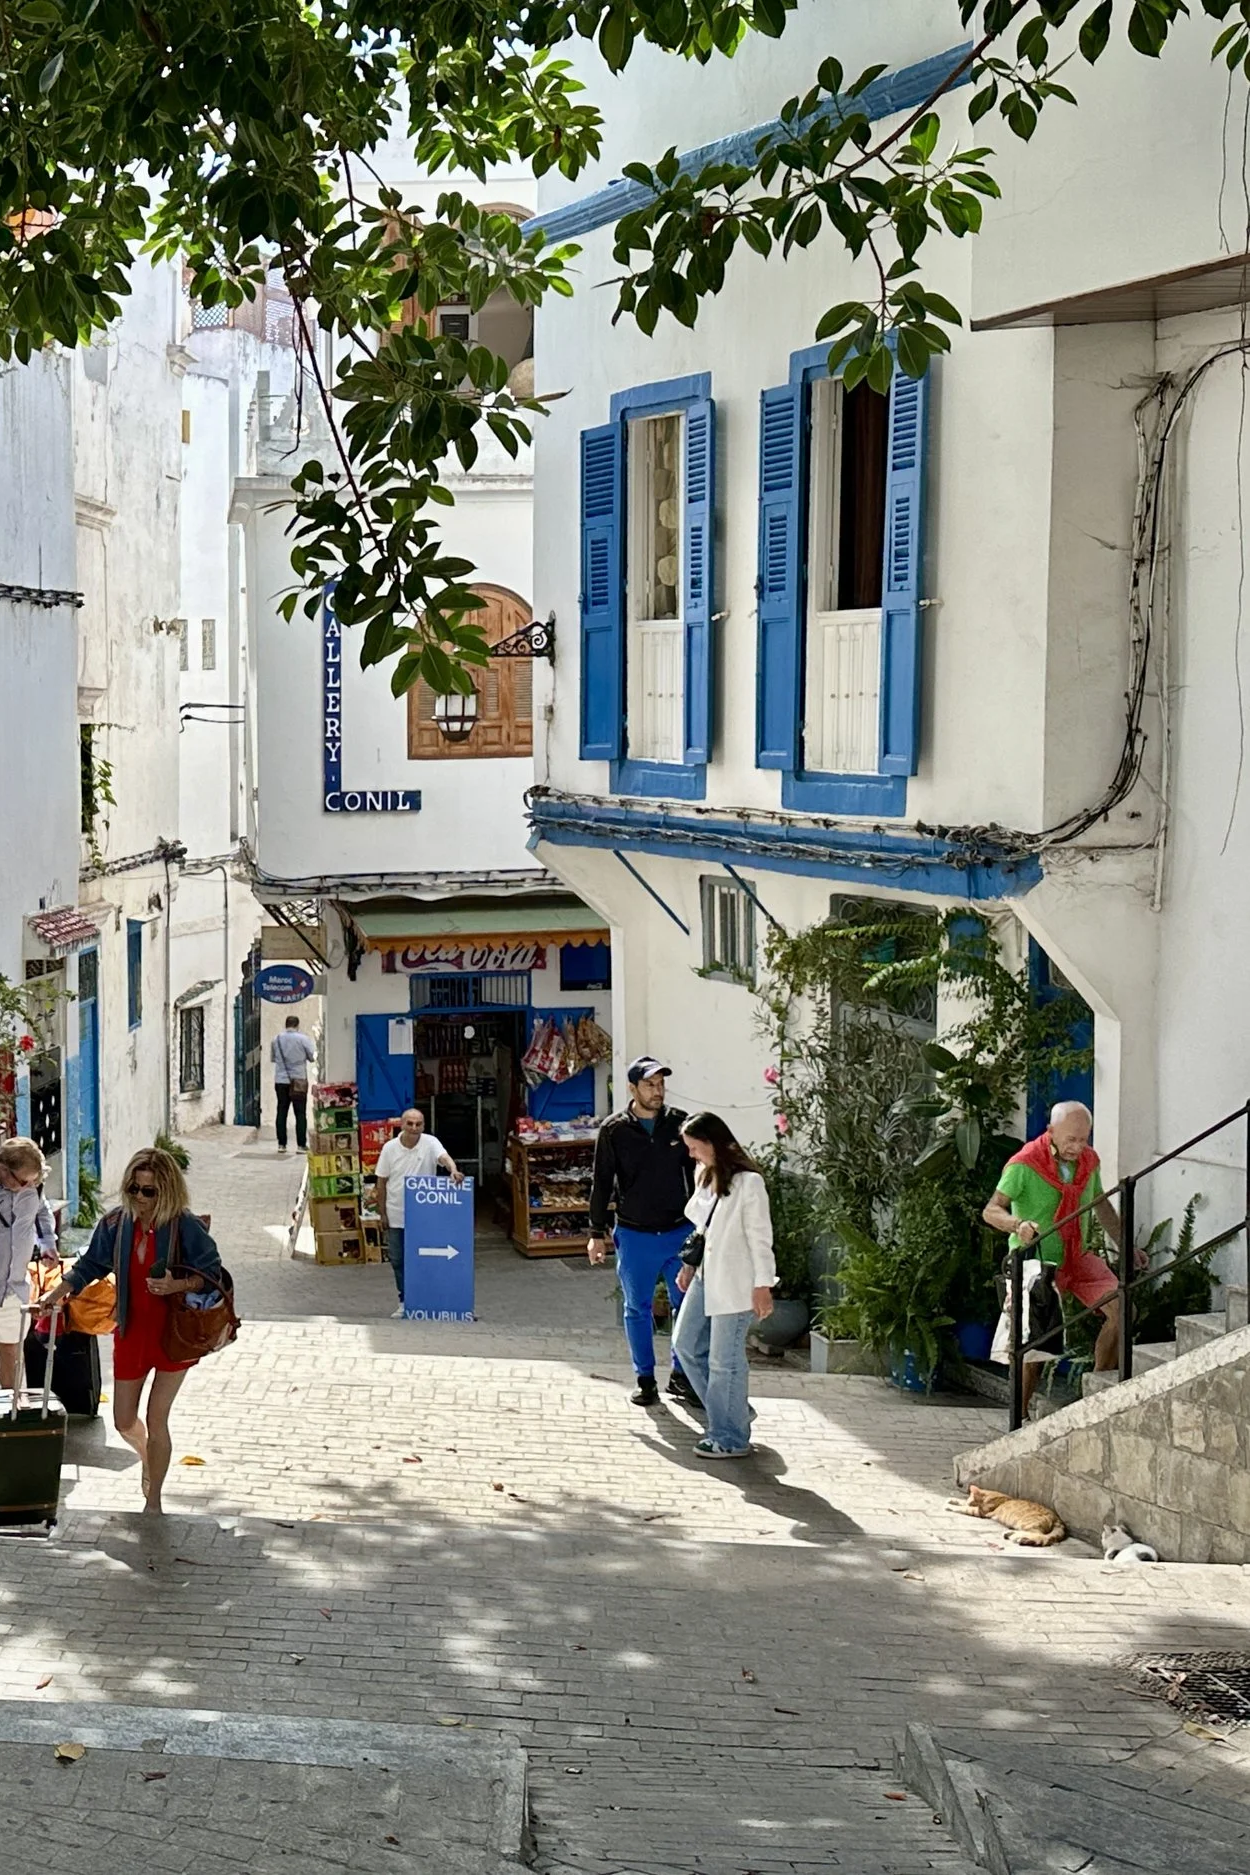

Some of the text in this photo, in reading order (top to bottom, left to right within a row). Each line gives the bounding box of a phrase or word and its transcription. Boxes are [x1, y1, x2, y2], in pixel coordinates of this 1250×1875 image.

[325, 791, 410, 811] CONIL
[268, 975, 293, 984] Maroc
[262, 983, 293, 991] Telecom
[415, 1191, 462, 1204] CONIL
[406, 1310, 474, 1324] VOLUBILIS
